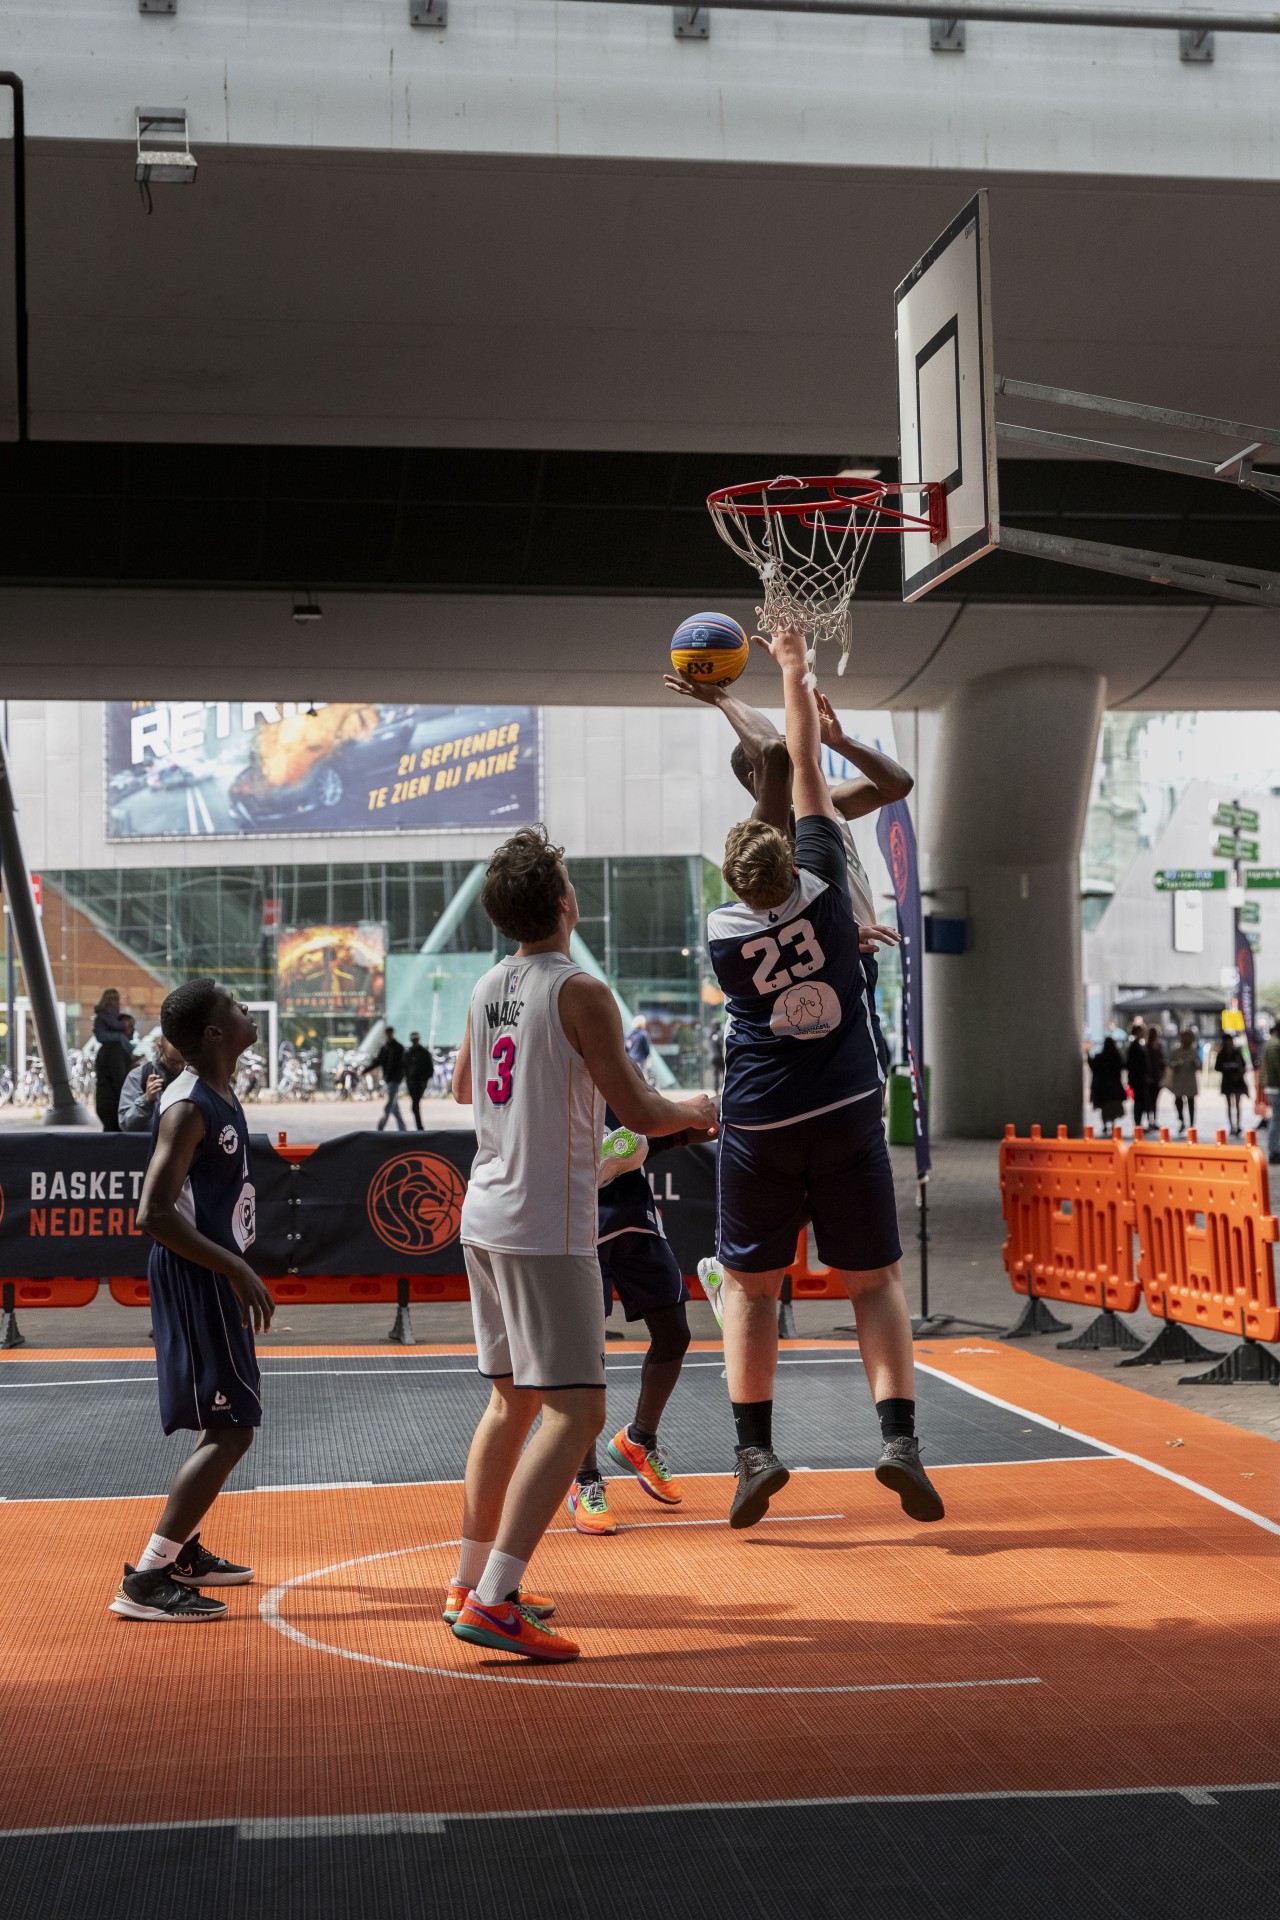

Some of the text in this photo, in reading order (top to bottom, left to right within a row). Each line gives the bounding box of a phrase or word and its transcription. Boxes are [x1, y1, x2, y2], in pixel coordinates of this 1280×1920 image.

[397, 723, 520, 777] 21 SEPTEMBER
[367, 744, 520, 811] TE ZIEN BIJ PATHÉ
[741, 918, 825, 995] 23
[484, 1000, 525, 1029] WADE
[486, 1033, 516, 1108] 3
[31, 1171, 144, 1200] BASKET
[29, 1207, 143, 1237] NEDERL
